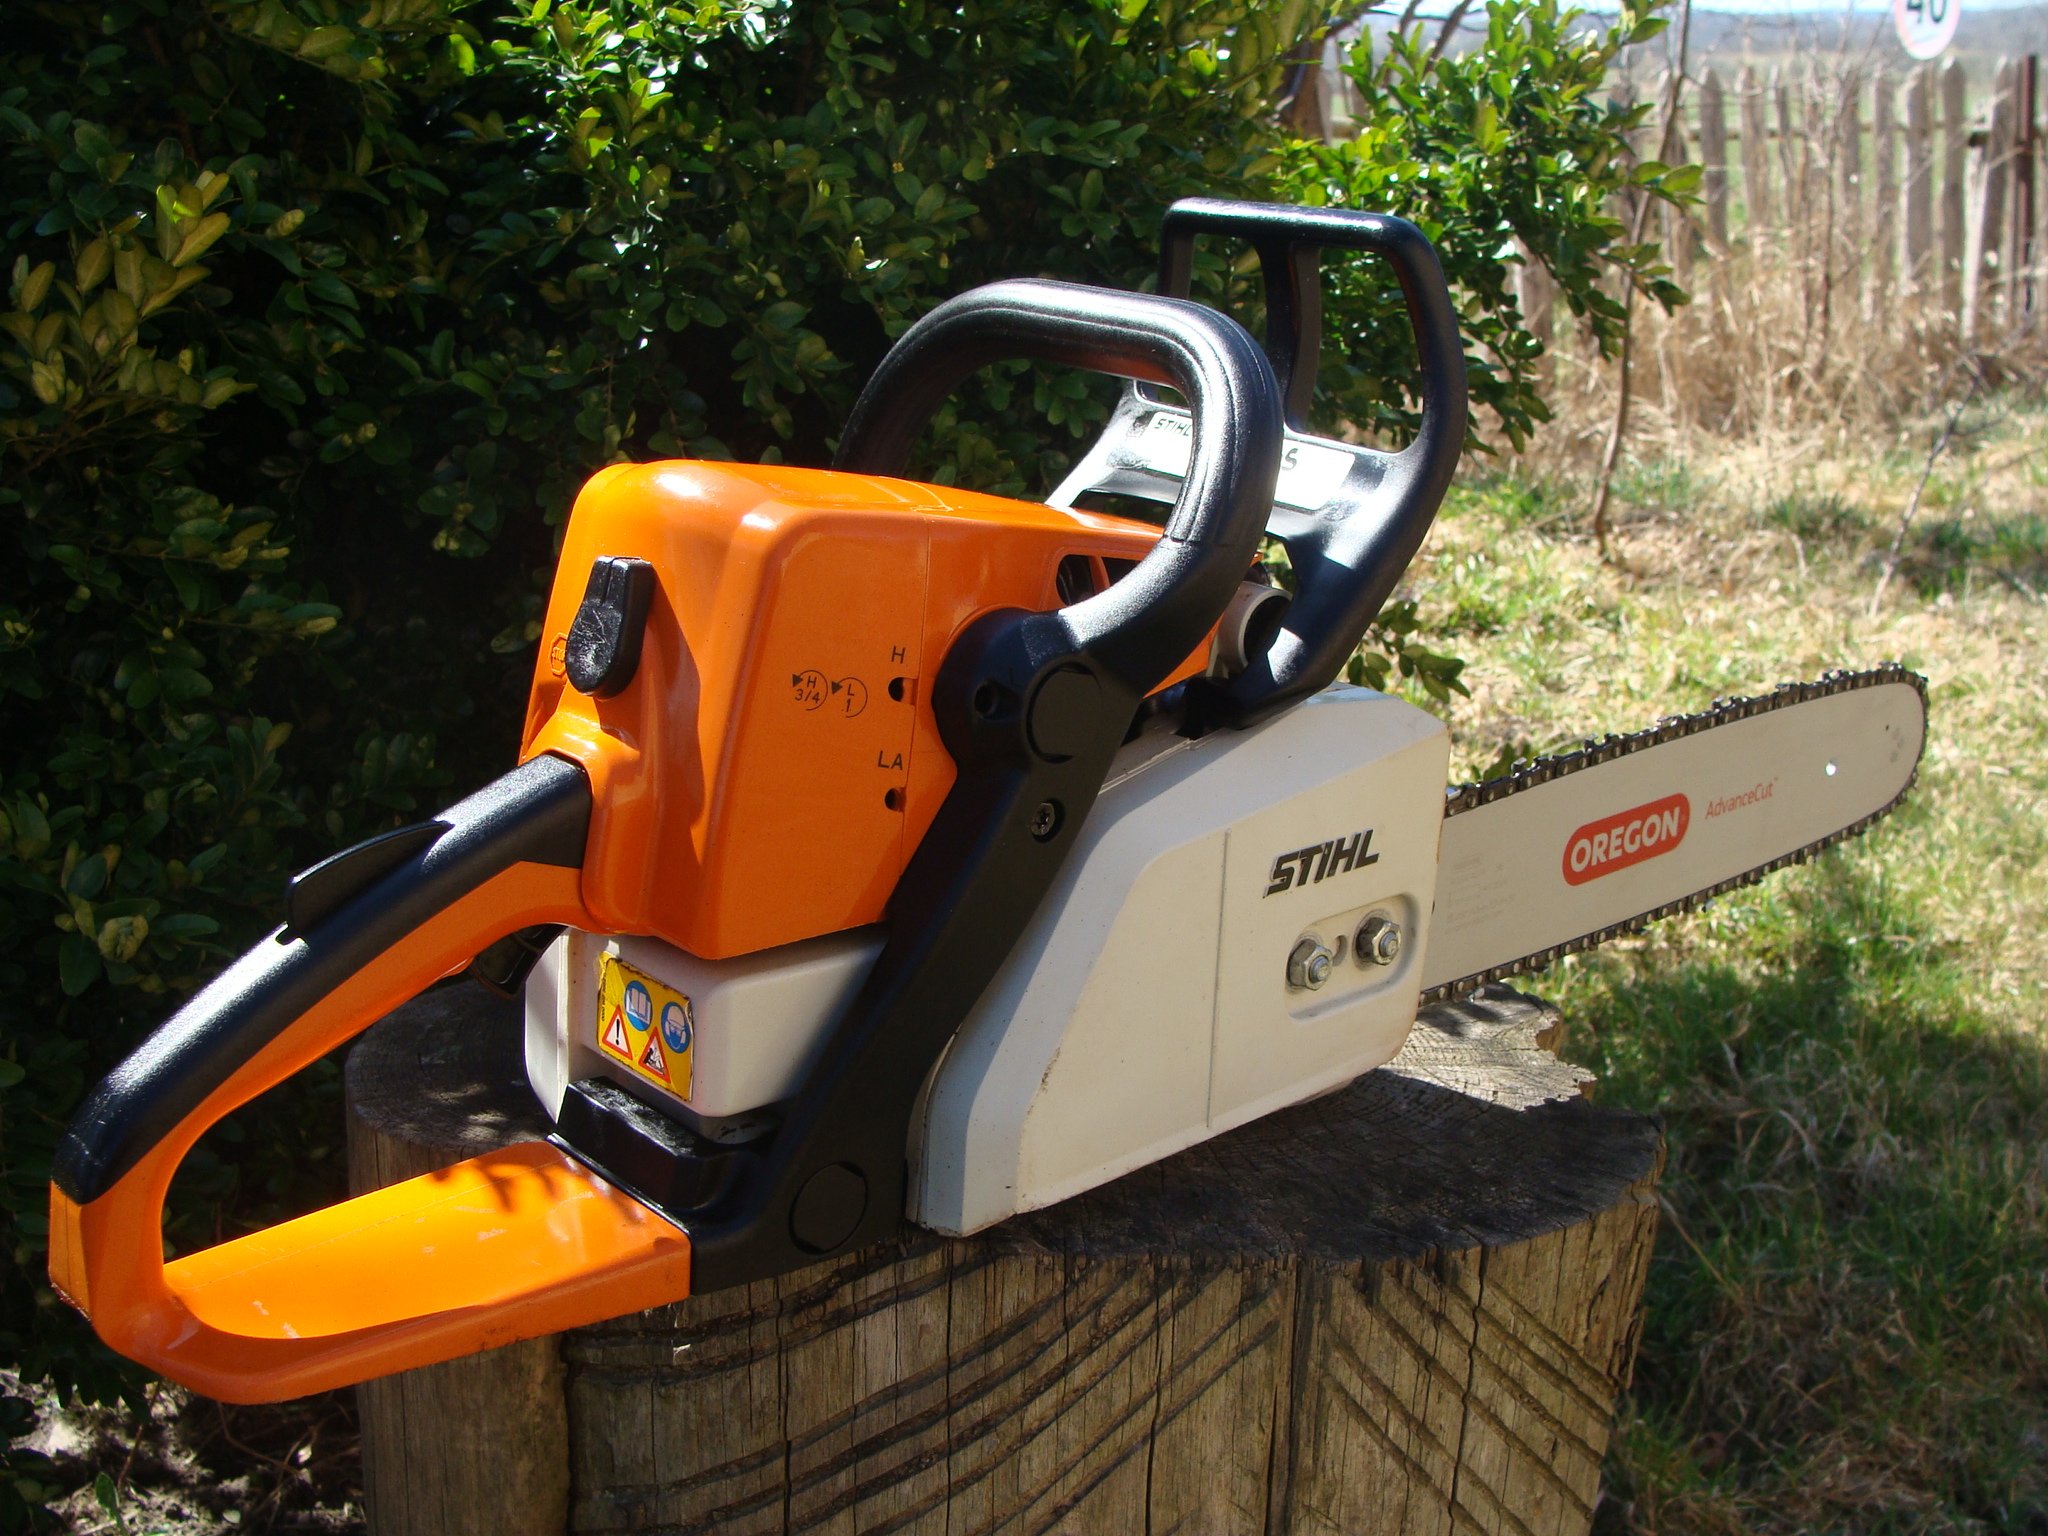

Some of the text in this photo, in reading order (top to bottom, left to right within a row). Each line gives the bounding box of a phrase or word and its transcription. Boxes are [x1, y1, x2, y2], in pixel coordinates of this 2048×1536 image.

[1154, 418, 1192, 437] STIHL
[891, 645, 906, 664] H
[806, 675, 817, 689] H
[847, 683, 855, 697] L
[794, 688, 821, 704] 3/4
[877, 750, 904, 771] LA
[1570, 806, 1681, 873] OREGON
[1263, 829, 1379, 898] STIHL
